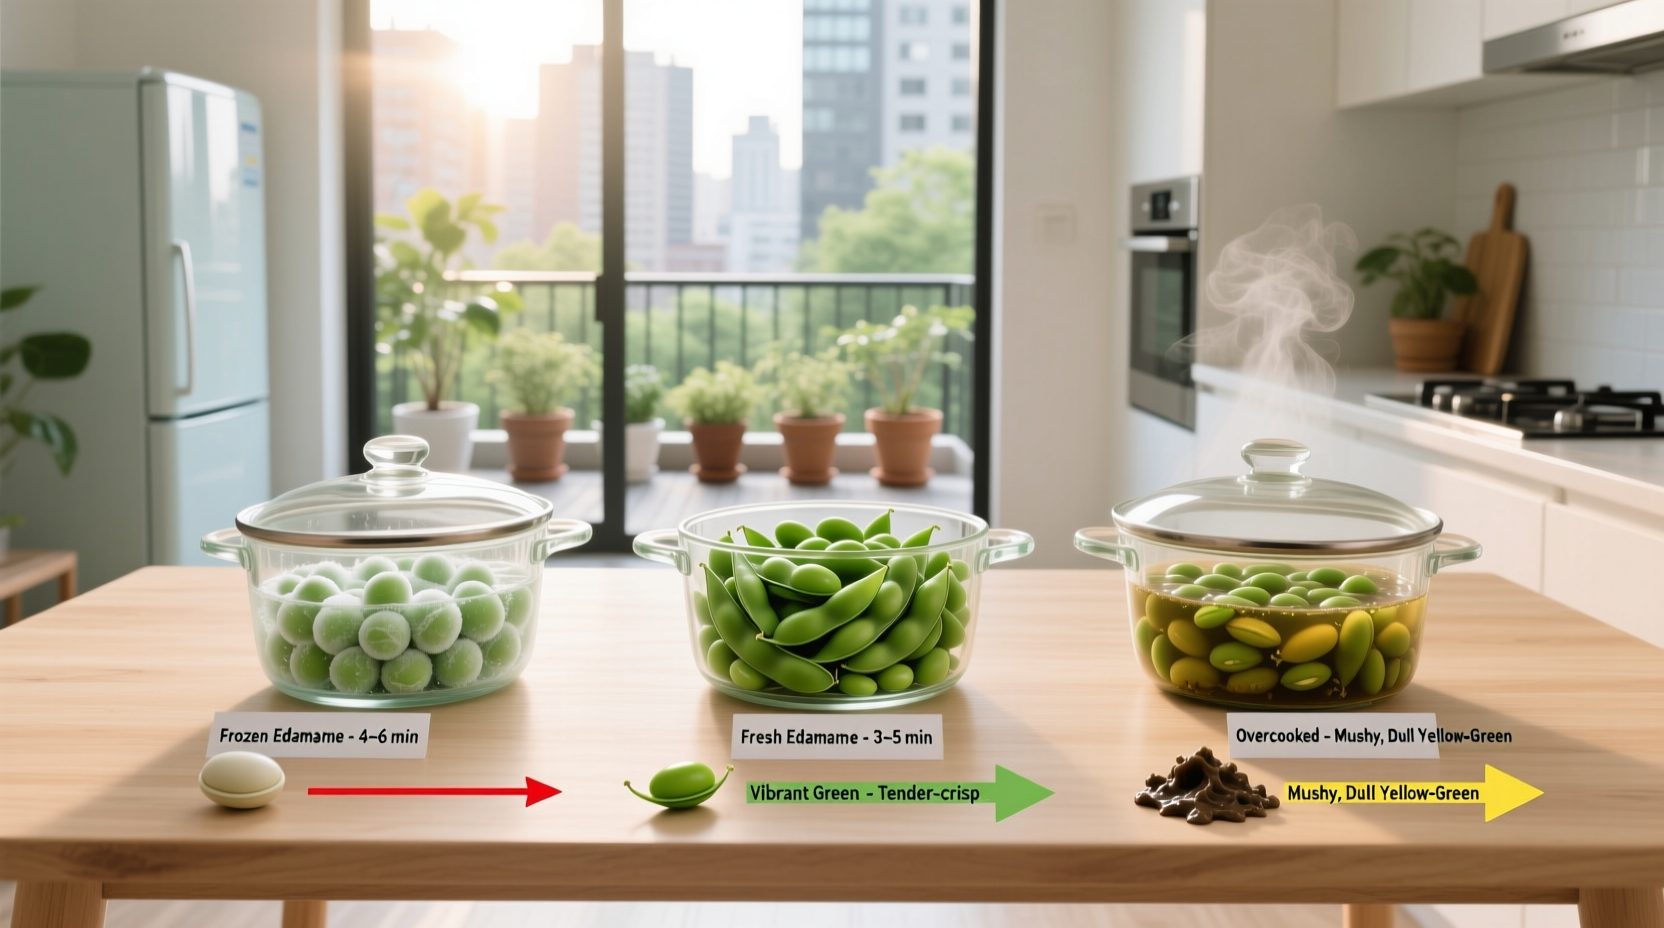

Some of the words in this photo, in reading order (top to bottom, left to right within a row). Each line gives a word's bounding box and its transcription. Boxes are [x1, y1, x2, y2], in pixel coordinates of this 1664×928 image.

[219, 727, 268, 743] Frozen
[273, 727, 344, 743] Edamame
[391, 728, 418, 744] min
[741, 729, 782, 744] Fresh
[786, 729, 858, 745] Edamame
[905, 729, 933, 745] min
[1236, 727, 1320, 743] Overcooked
[1334, 728, 1384, 746] Mushy,
[1388, 728, 1415, 743] Dull
[1417, 728, 1513, 743] Yellow-Green
